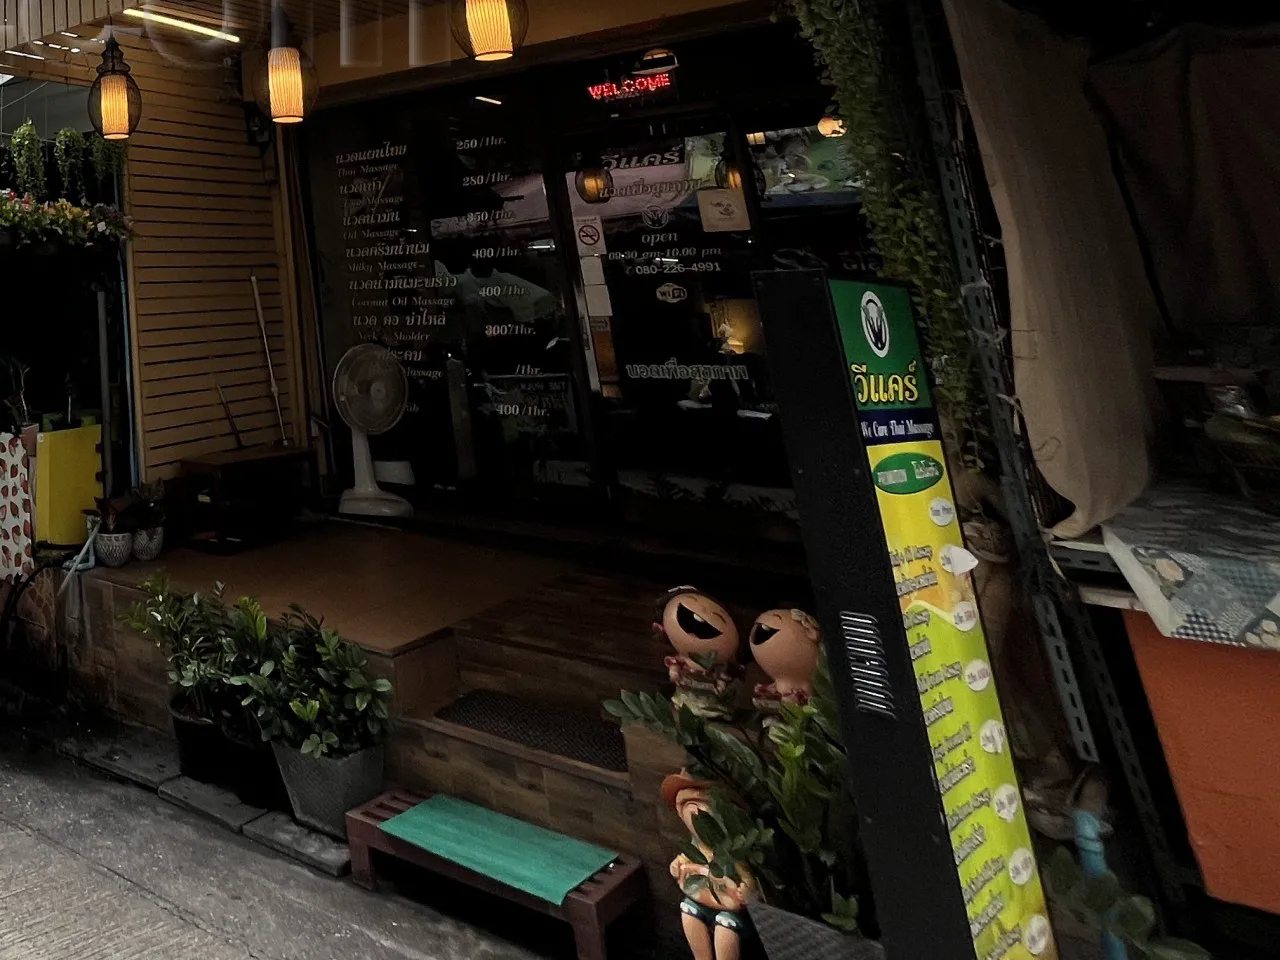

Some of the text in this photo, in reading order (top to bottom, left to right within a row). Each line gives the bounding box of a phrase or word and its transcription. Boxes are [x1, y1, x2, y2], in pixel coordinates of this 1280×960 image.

[588, 71, 671, 101] WELCOME
[335, 141, 408, 165] นวดแผนไทย
[641, 231, 679, 246] open
[411, 295, 456, 309] Massage
[352, 314, 378, 326] นวด
[850, 359, 919, 404] วีแคร์
